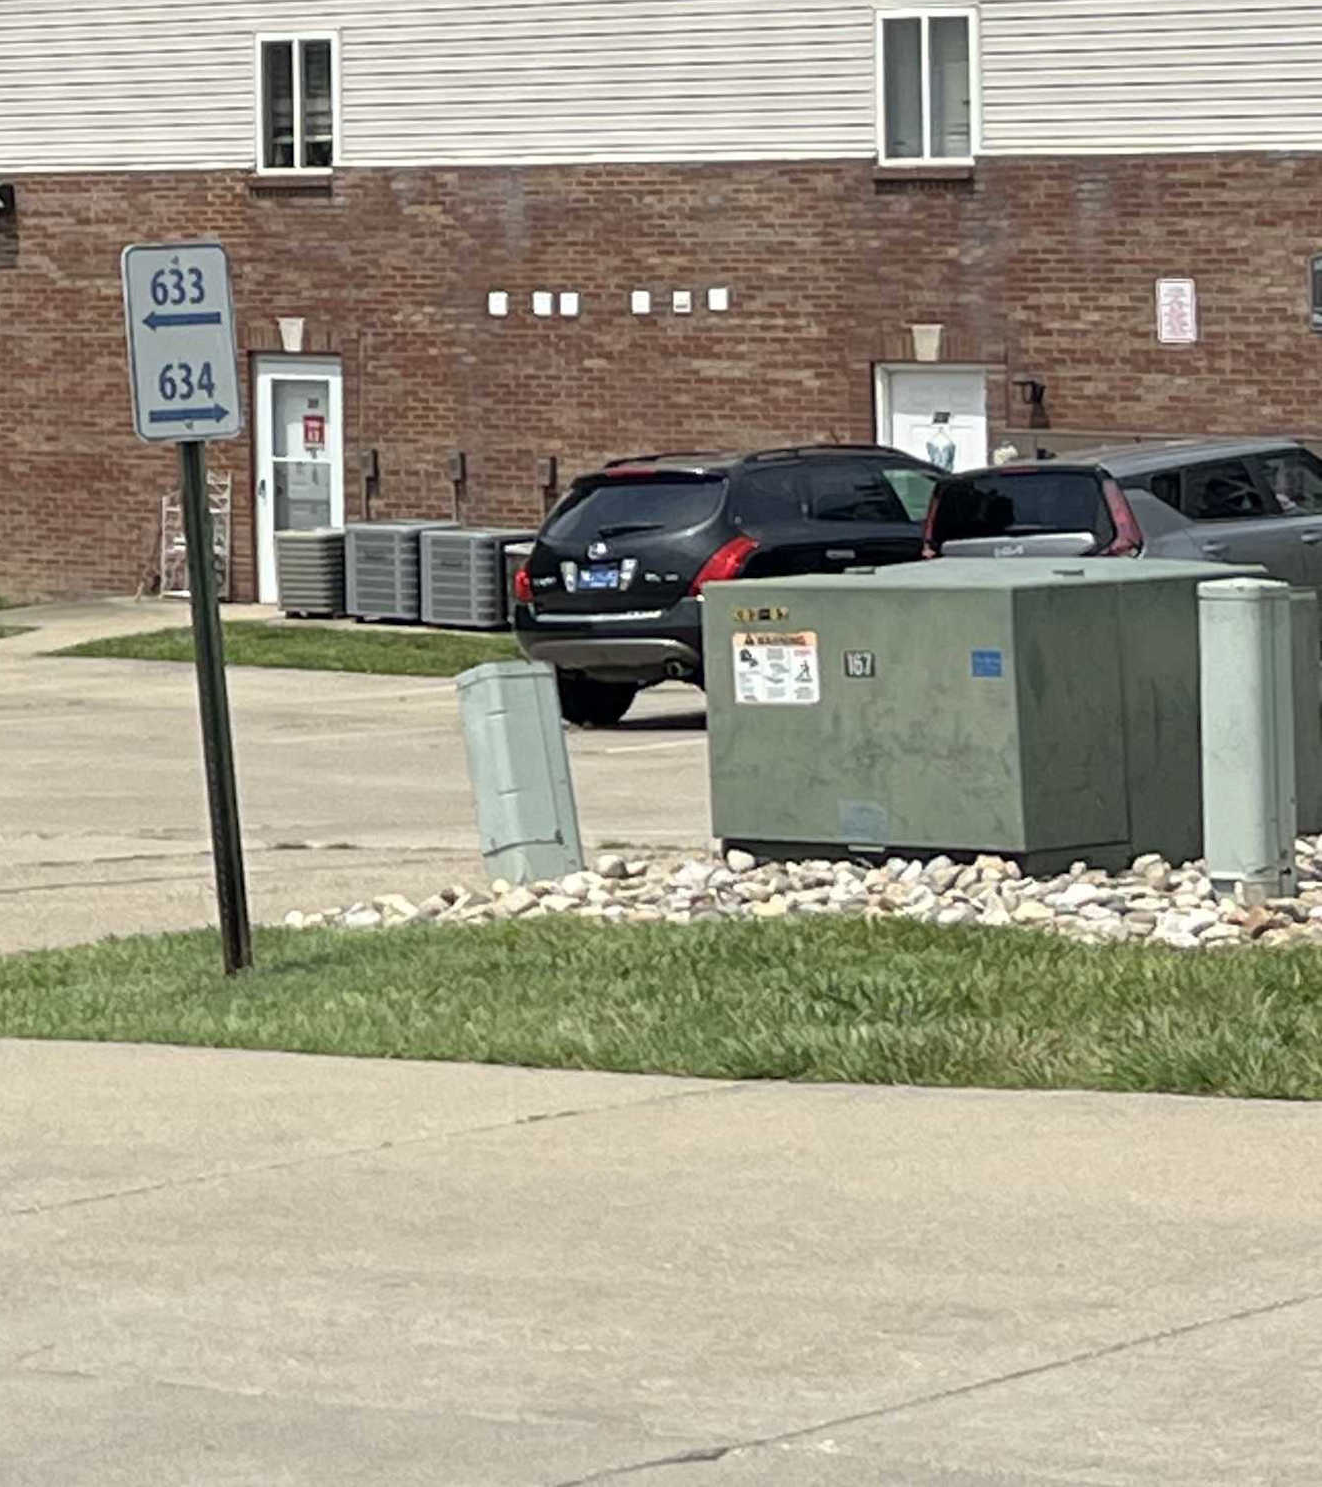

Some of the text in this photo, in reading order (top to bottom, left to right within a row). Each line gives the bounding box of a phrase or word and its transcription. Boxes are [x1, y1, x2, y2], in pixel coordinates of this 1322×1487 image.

[150, 267, 205, 306] 633
[159, 362, 215, 400] 634
[846, 651, 872, 676] 167
